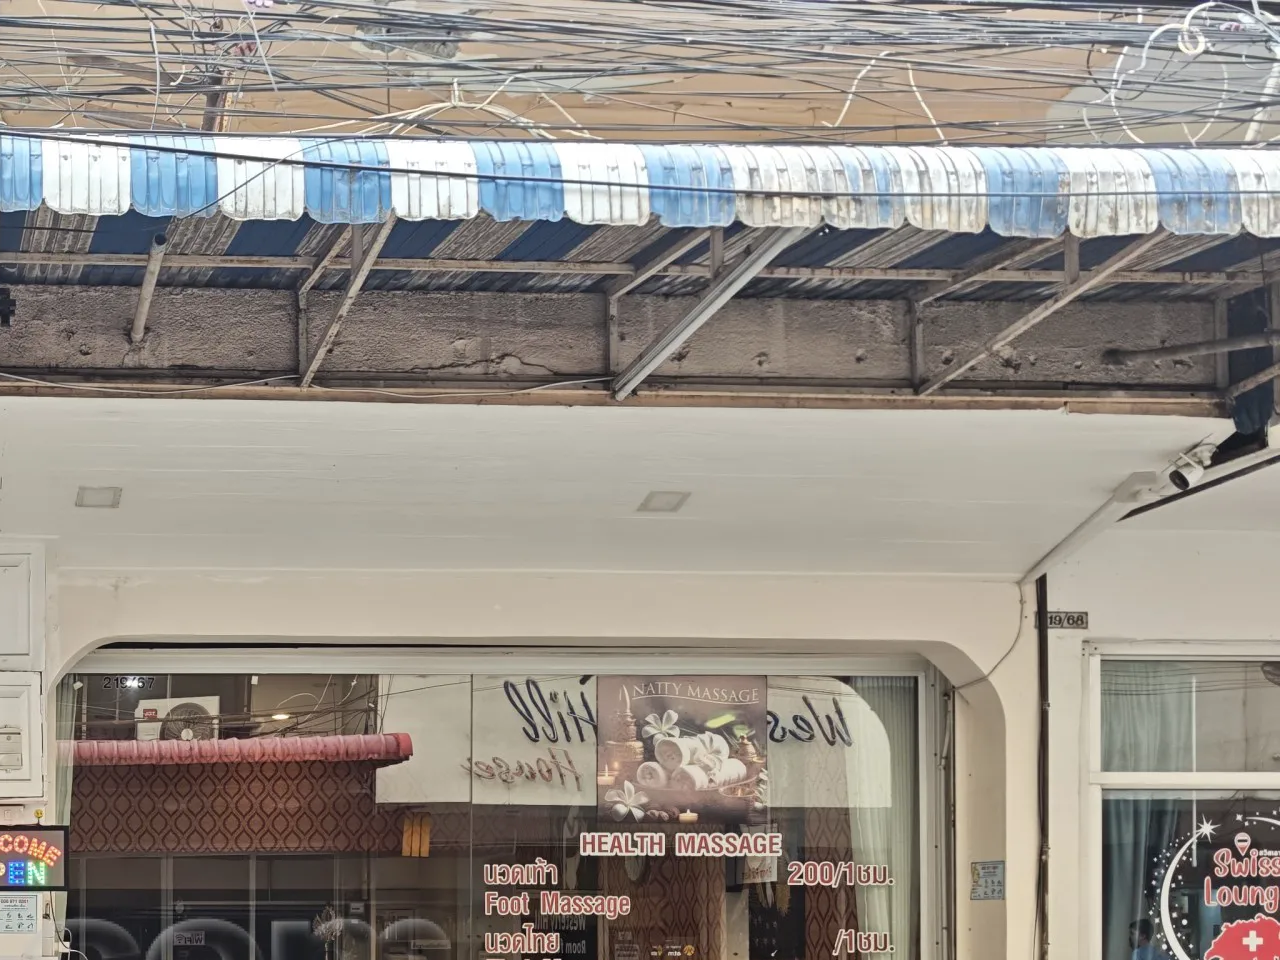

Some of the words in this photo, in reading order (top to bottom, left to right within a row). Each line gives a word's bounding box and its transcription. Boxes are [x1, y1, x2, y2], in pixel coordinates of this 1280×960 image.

[1048, 613, 1085, 627] 19/68
[103, 676, 155, 689] 219/67
[632, 682, 682, 698] NATTY
[688, 684, 760, 703] MASSAGE
[580, 832, 666, 857] HEALTH
[675, 832, 782, 858] MASSAGE
[483, 859, 558, 886] นวดเท้า
[787, 861, 895, 888] 200/1ชม.
[1213, 848, 1280, 878] Swiss
[484, 891, 530, 917] Foot
[540, 891, 631, 920] Massage
[1204, 876, 1280, 914] Loung
[484, 923, 561, 955] นวดไทย
[832, 929, 895, 956] /1ชม.
